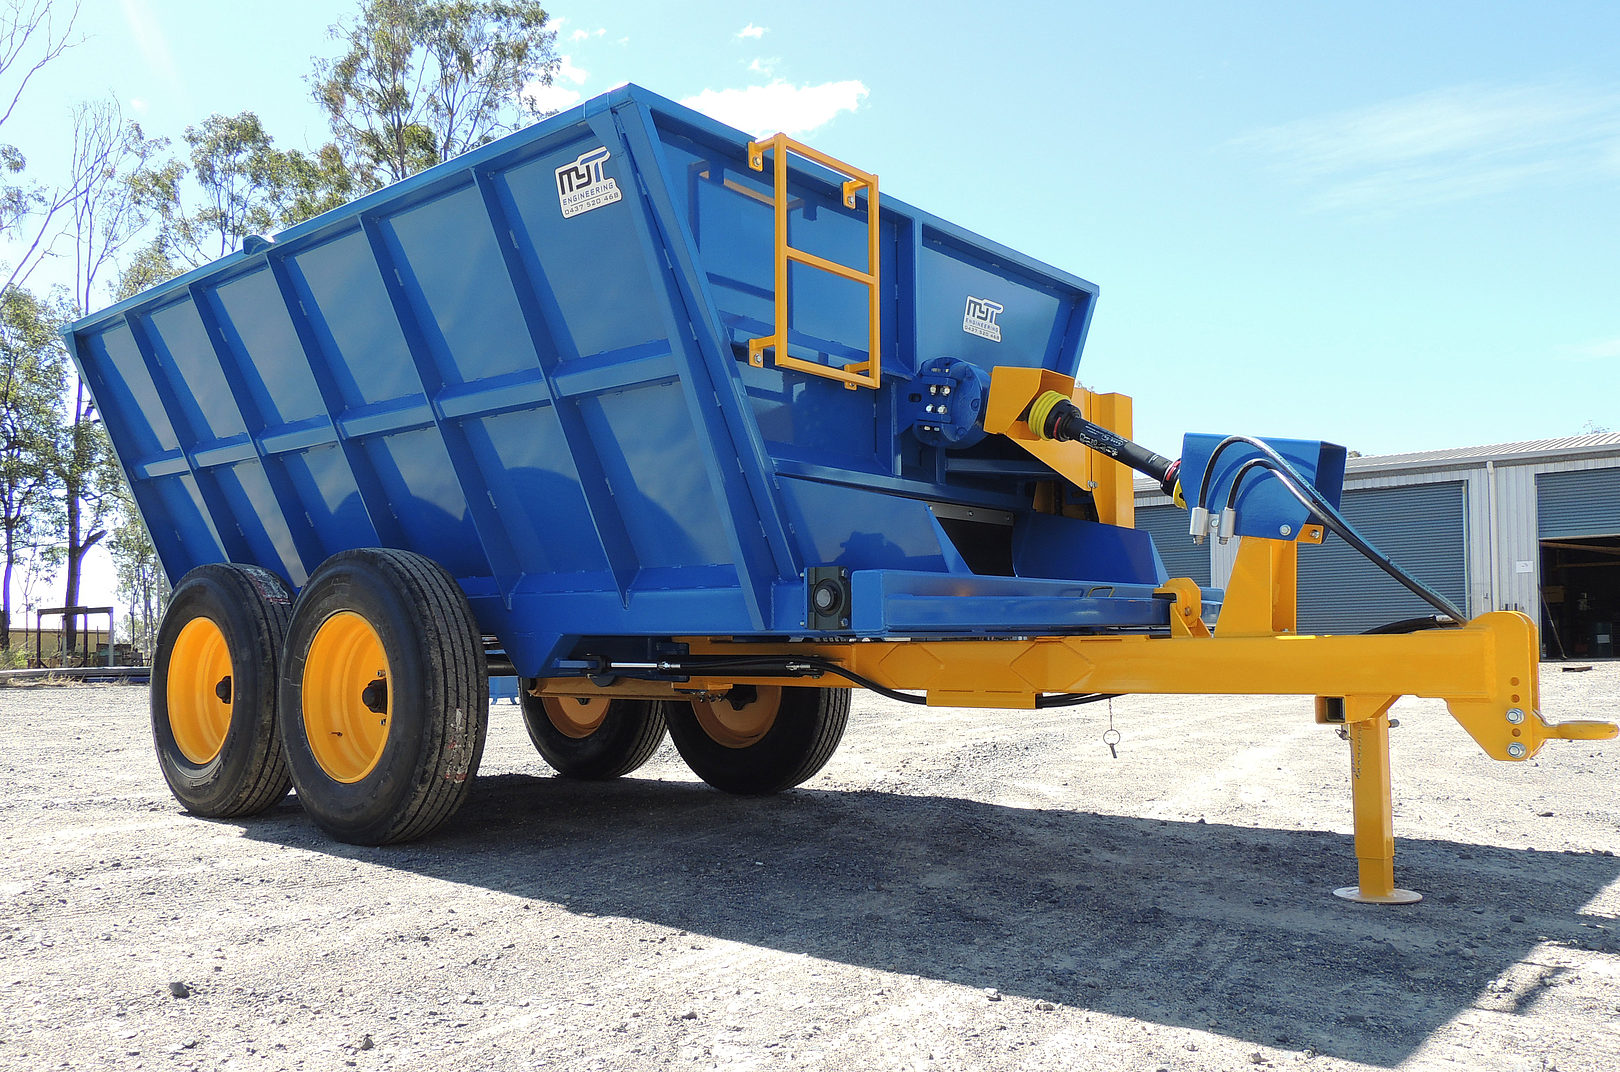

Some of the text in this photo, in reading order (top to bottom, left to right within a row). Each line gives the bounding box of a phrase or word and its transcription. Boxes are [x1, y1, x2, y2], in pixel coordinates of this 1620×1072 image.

[563, 182, 614, 205] ENGINEERING
[565, 204, 583, 215] 0437
[586, 199, 602, 208] 520
